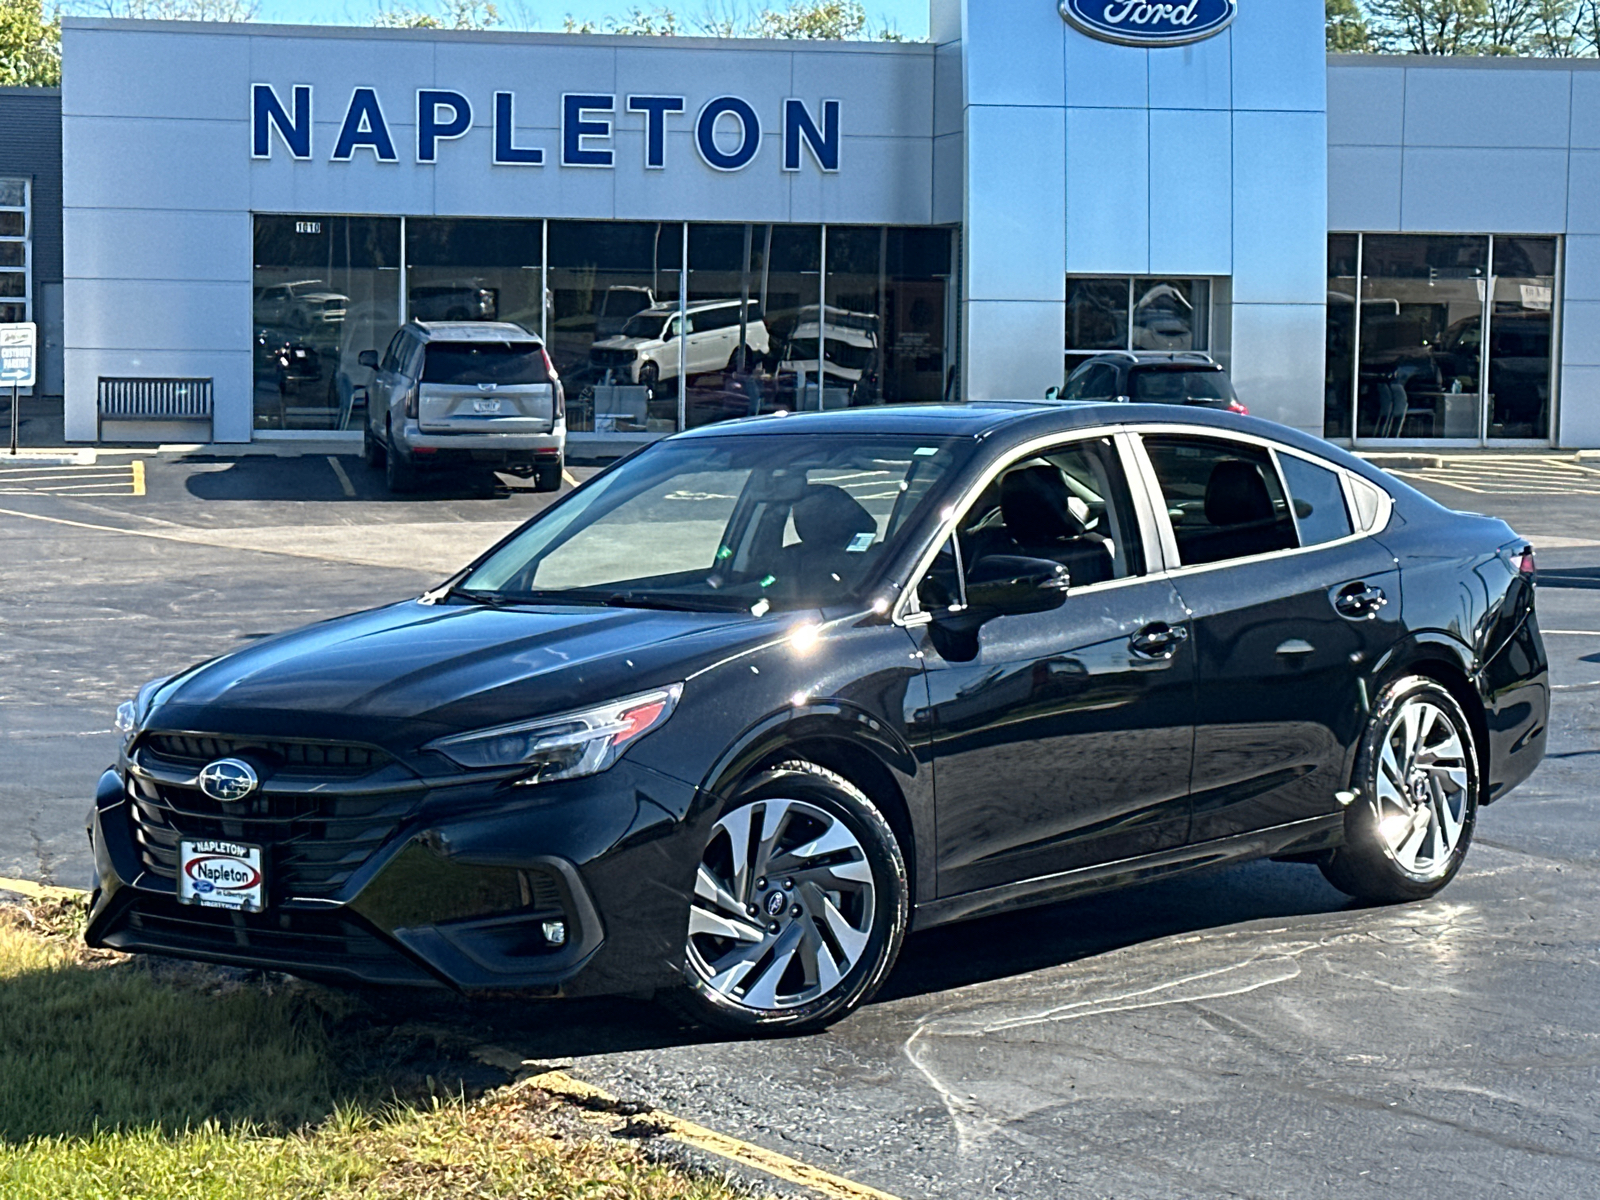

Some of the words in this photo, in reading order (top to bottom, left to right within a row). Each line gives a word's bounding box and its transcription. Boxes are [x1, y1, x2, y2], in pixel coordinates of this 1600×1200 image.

[1103, 0, 1199, 26] Ford
[250, 83, 842, 174] NAPLETON
[3, 358, 29, 370] PARKING
[196, 841, 247, 856] NAPLETON
[197, 863, 249, 883] Napleton
